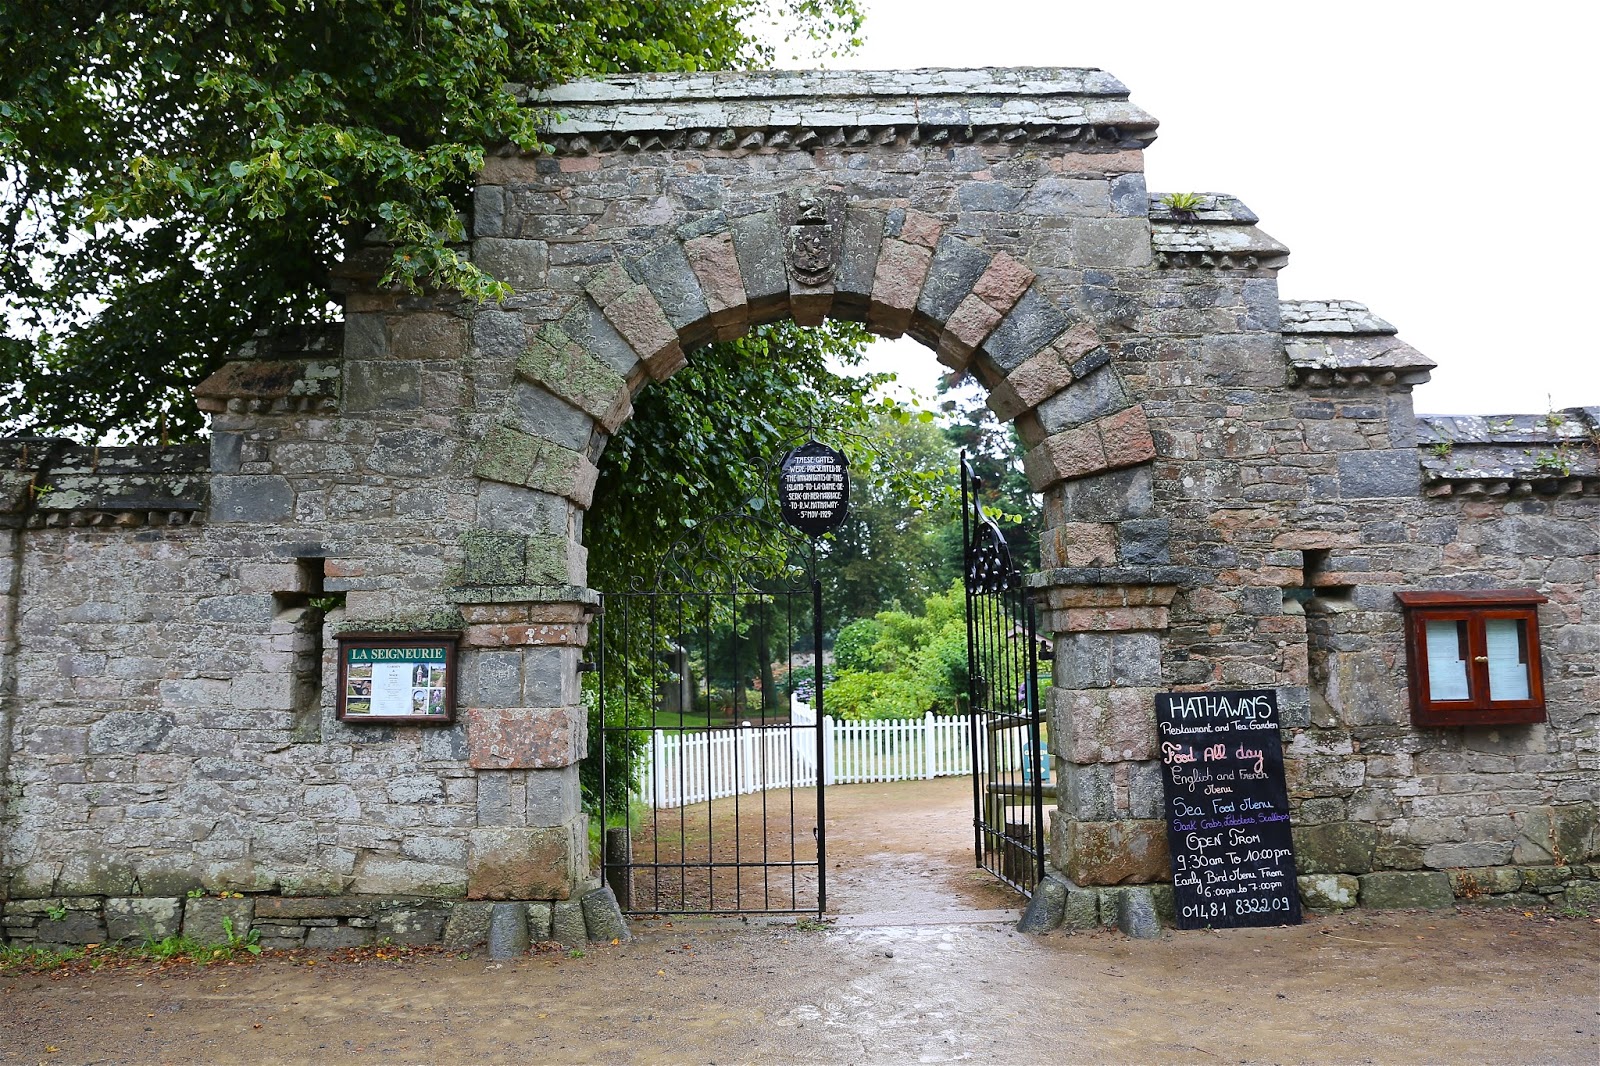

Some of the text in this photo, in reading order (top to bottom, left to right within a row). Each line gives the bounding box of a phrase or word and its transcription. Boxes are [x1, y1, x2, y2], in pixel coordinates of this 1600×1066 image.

[352, 648, 443, 660] LA SEIGNEURIE
[1169, 695, 1272, 720] HATHAWAYS
[1160, 720, 1278, 735] Restaurant and Tea Garden
[1162, 741, 1264, 773] Food All day
[1170, 766, 1269, 792] English and French
[1204, 784, 1234, 795] Menu
[1172, 796, 1274, 816] Sea Food Menu
[1225, 852, 1241, 864] To
[1174, 866, 1284, 894] Early Bird Menu From
[1182, 902, 1227, 920] 01481
